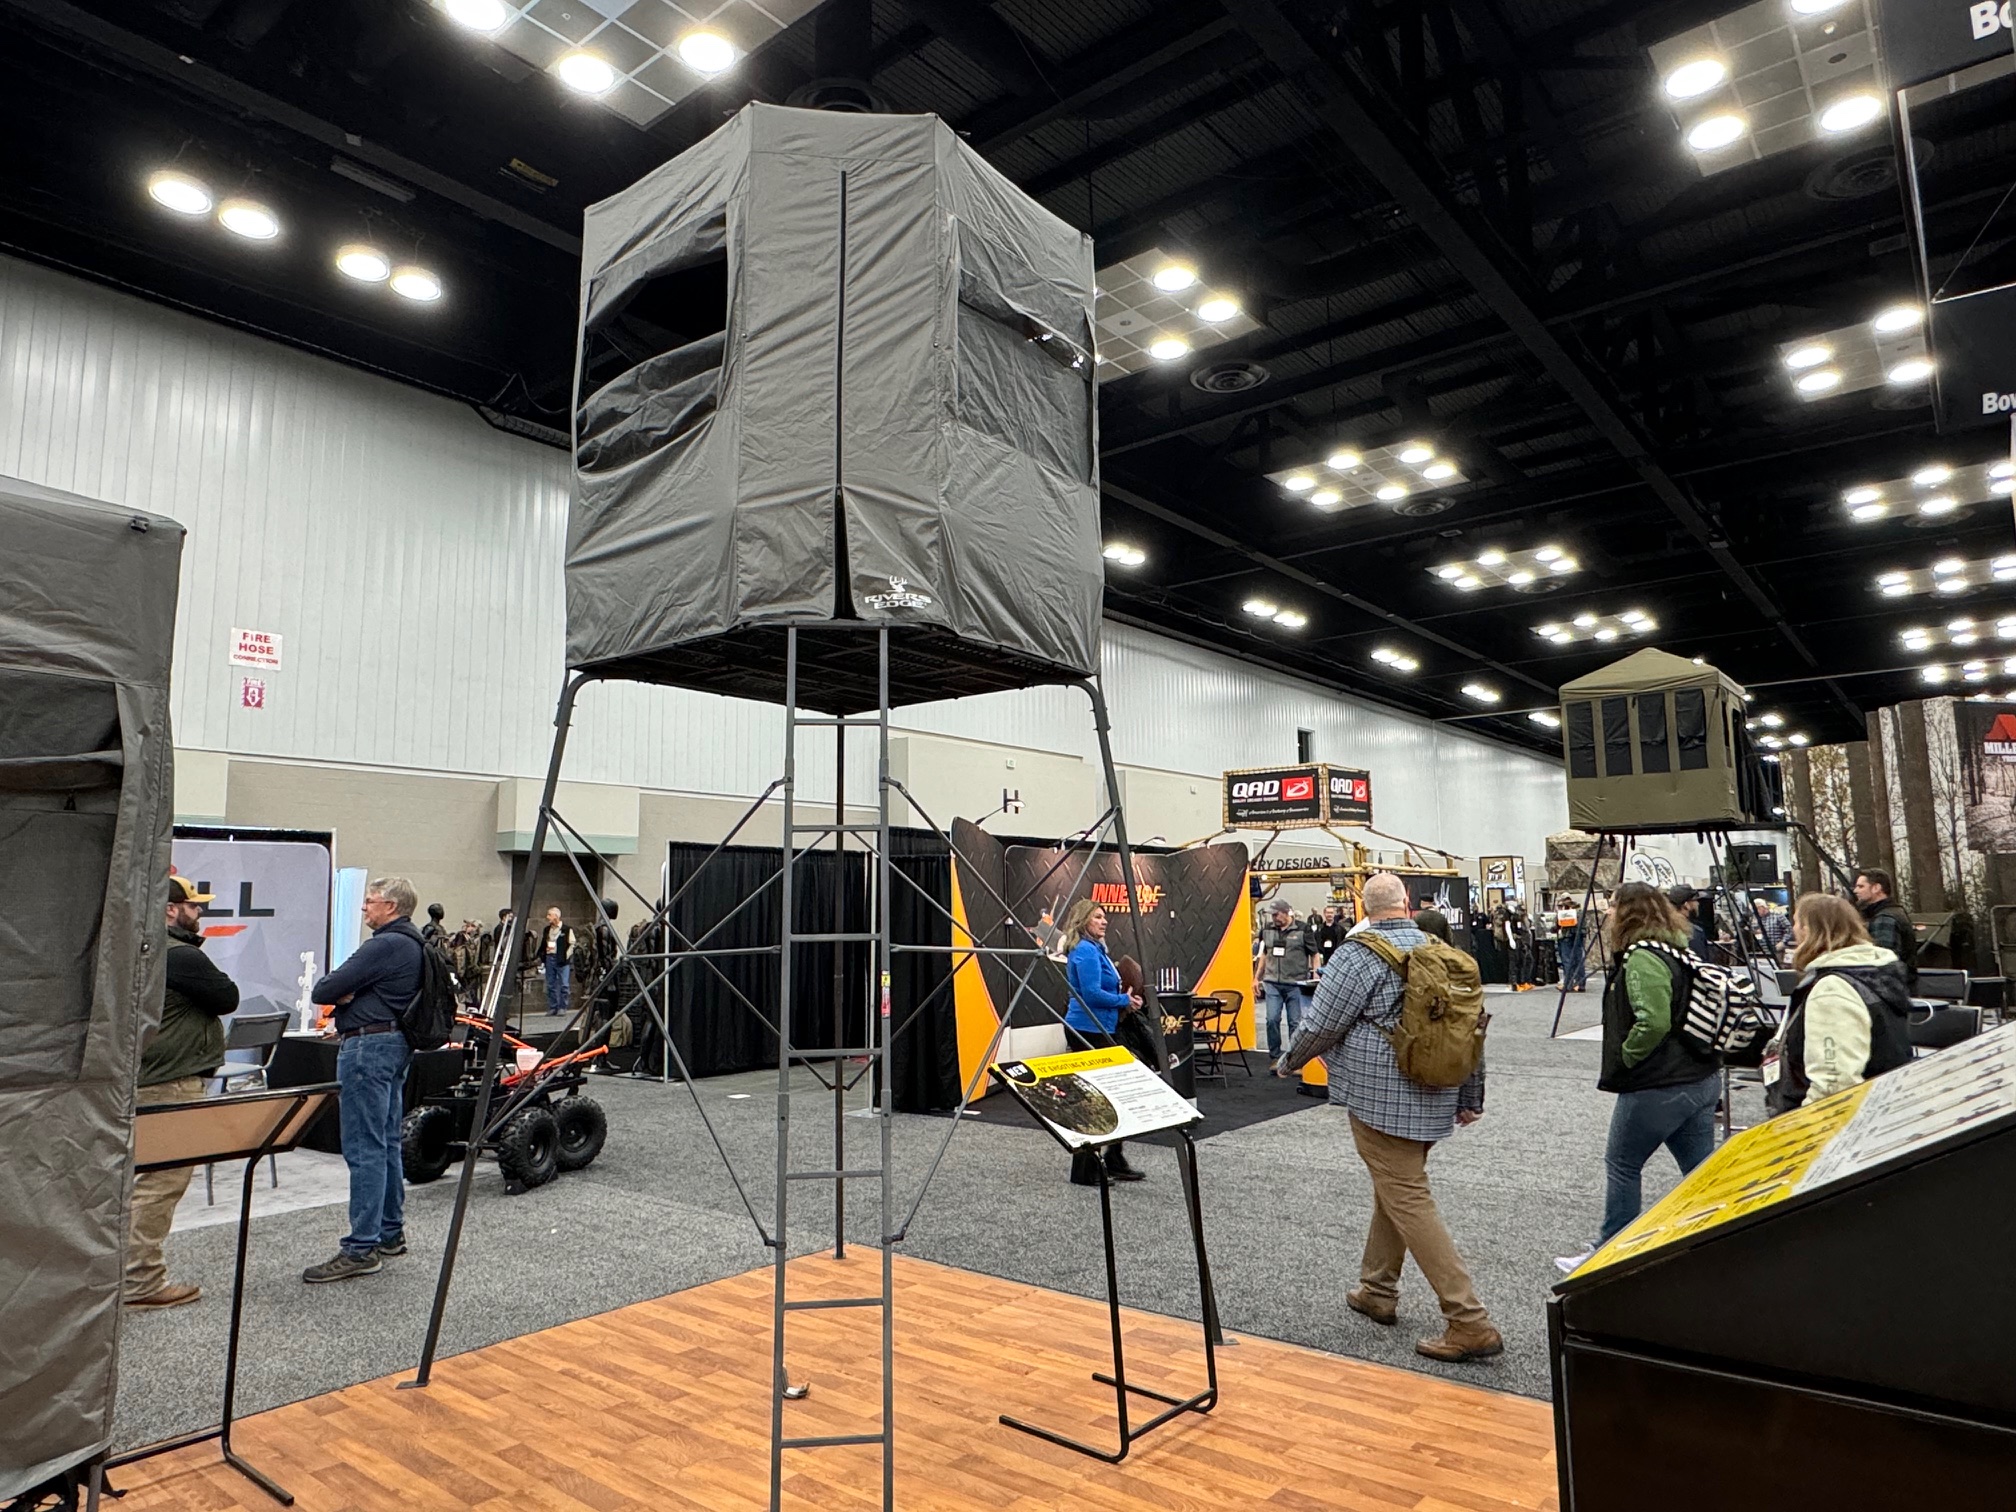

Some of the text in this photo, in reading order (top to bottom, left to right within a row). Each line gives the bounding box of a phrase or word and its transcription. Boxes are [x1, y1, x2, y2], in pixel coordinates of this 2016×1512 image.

[864, 592, 932, 604] RIVERS
[873, 600, 926, 610] EDGE
[242, 632, 272, 644] FIRE
[238, 642, 275, 655] HOSE
[1232, 780, 1280, 798] QAD
[1330, 777, 1353, 794] QAD
[1003, 788, 1019, 814] H
[1276, 856, 1331, 870] DESIGNS
[1081, 1057, 1114, 1068] PLATFORM
[1005, 1063, 1028, 1078] NEW
